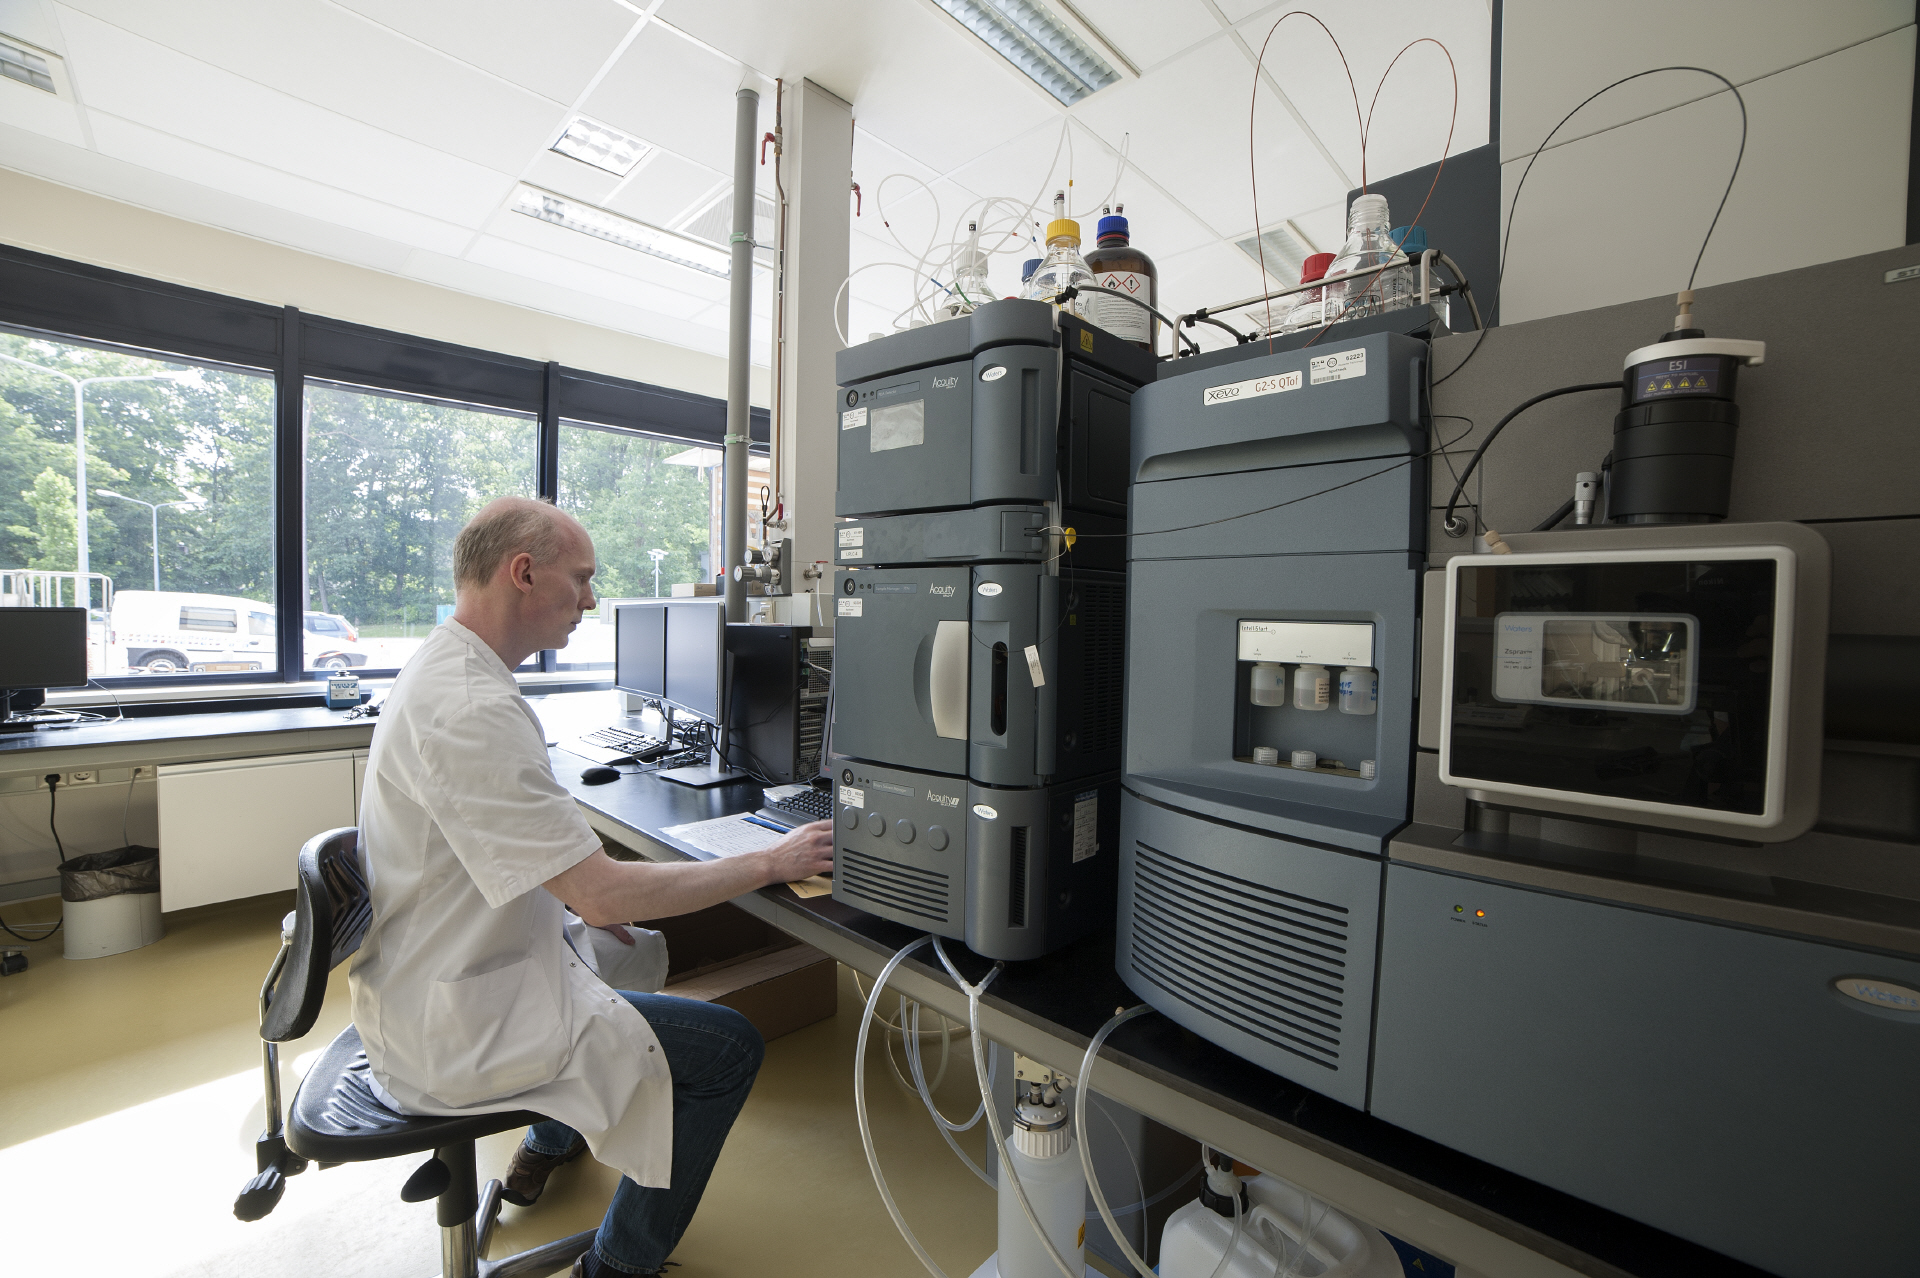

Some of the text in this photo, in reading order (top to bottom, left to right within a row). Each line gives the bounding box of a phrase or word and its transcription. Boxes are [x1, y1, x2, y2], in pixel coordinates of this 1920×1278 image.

[1669, 360, 1687, 371] ESI
[986, 370, 1002, 378] Waters
[1255, 374, 1300, 393] G2-S QTof
[929, 582, 956, 598] Acquity
[1504, 624, 1532, 632] Waters
[978, 806, 994, 816] Waters
[1854, 982, 1918, 1008] Waters
